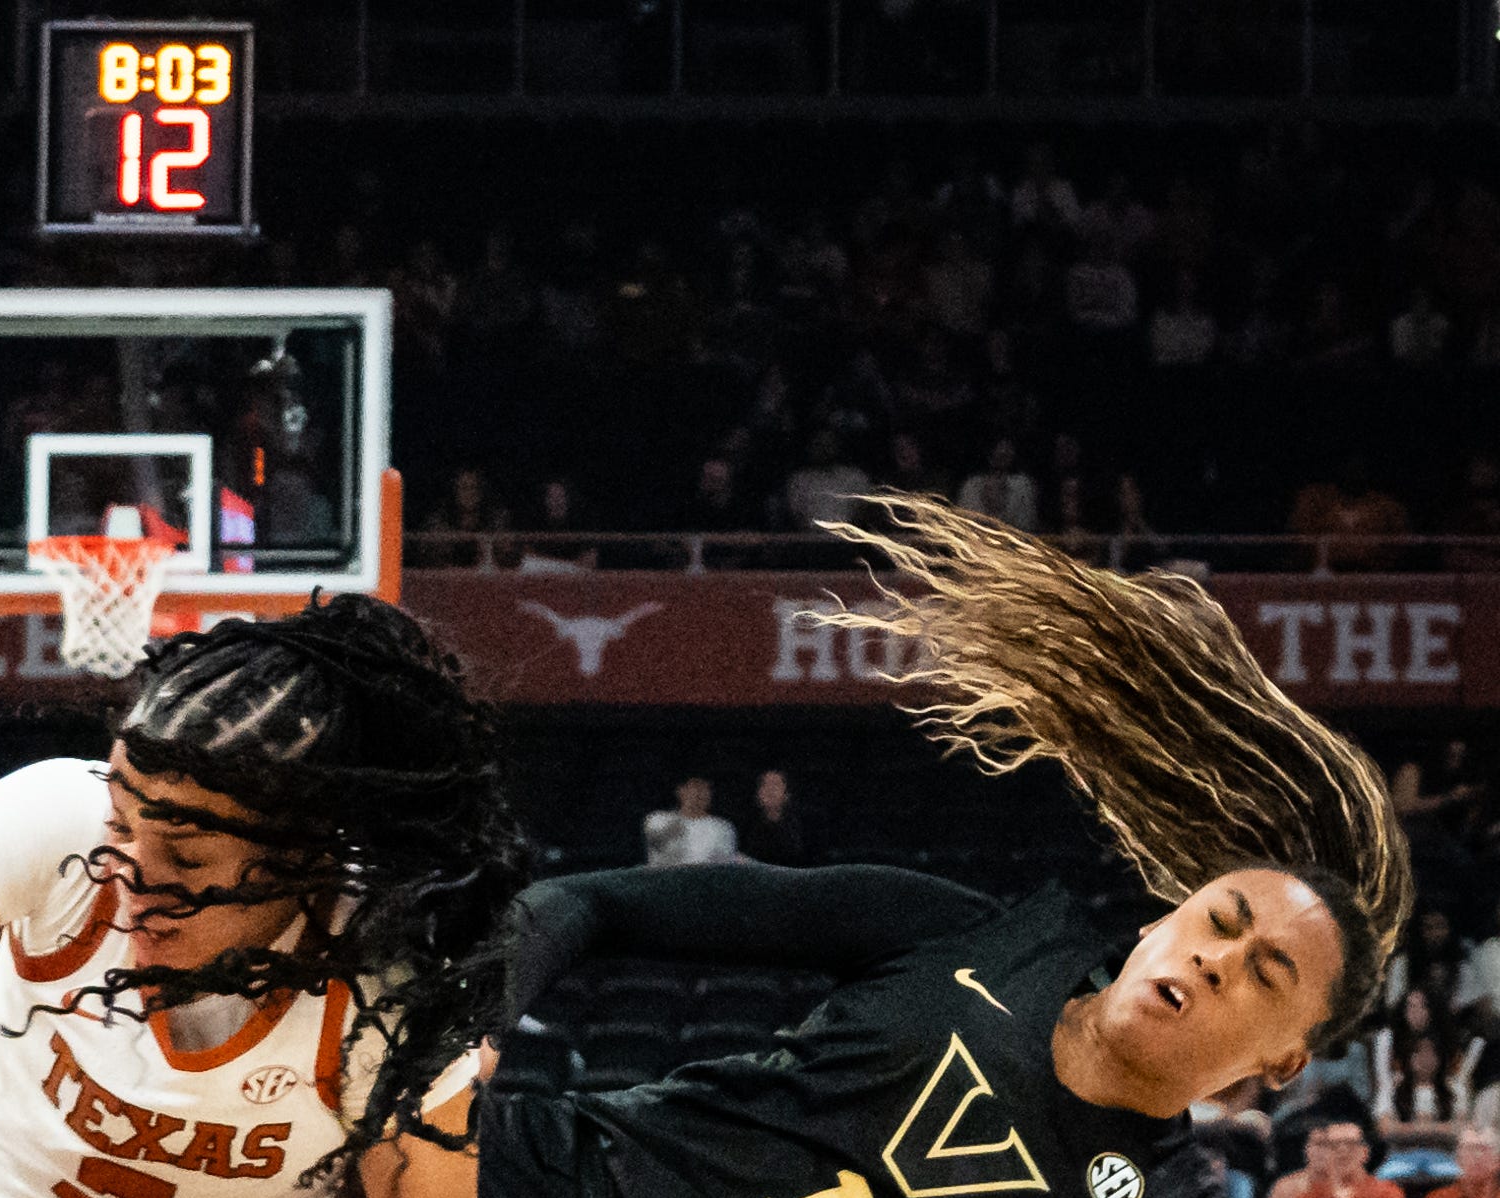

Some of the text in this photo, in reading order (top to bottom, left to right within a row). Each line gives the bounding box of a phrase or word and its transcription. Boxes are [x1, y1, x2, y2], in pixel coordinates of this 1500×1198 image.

[99, 42, 232, 104] 8:03
[117, 106, 211, 211] 12
[771, 597, 1461, 684] HO THE
[41, 1030, 292, 1179] TEXAS
